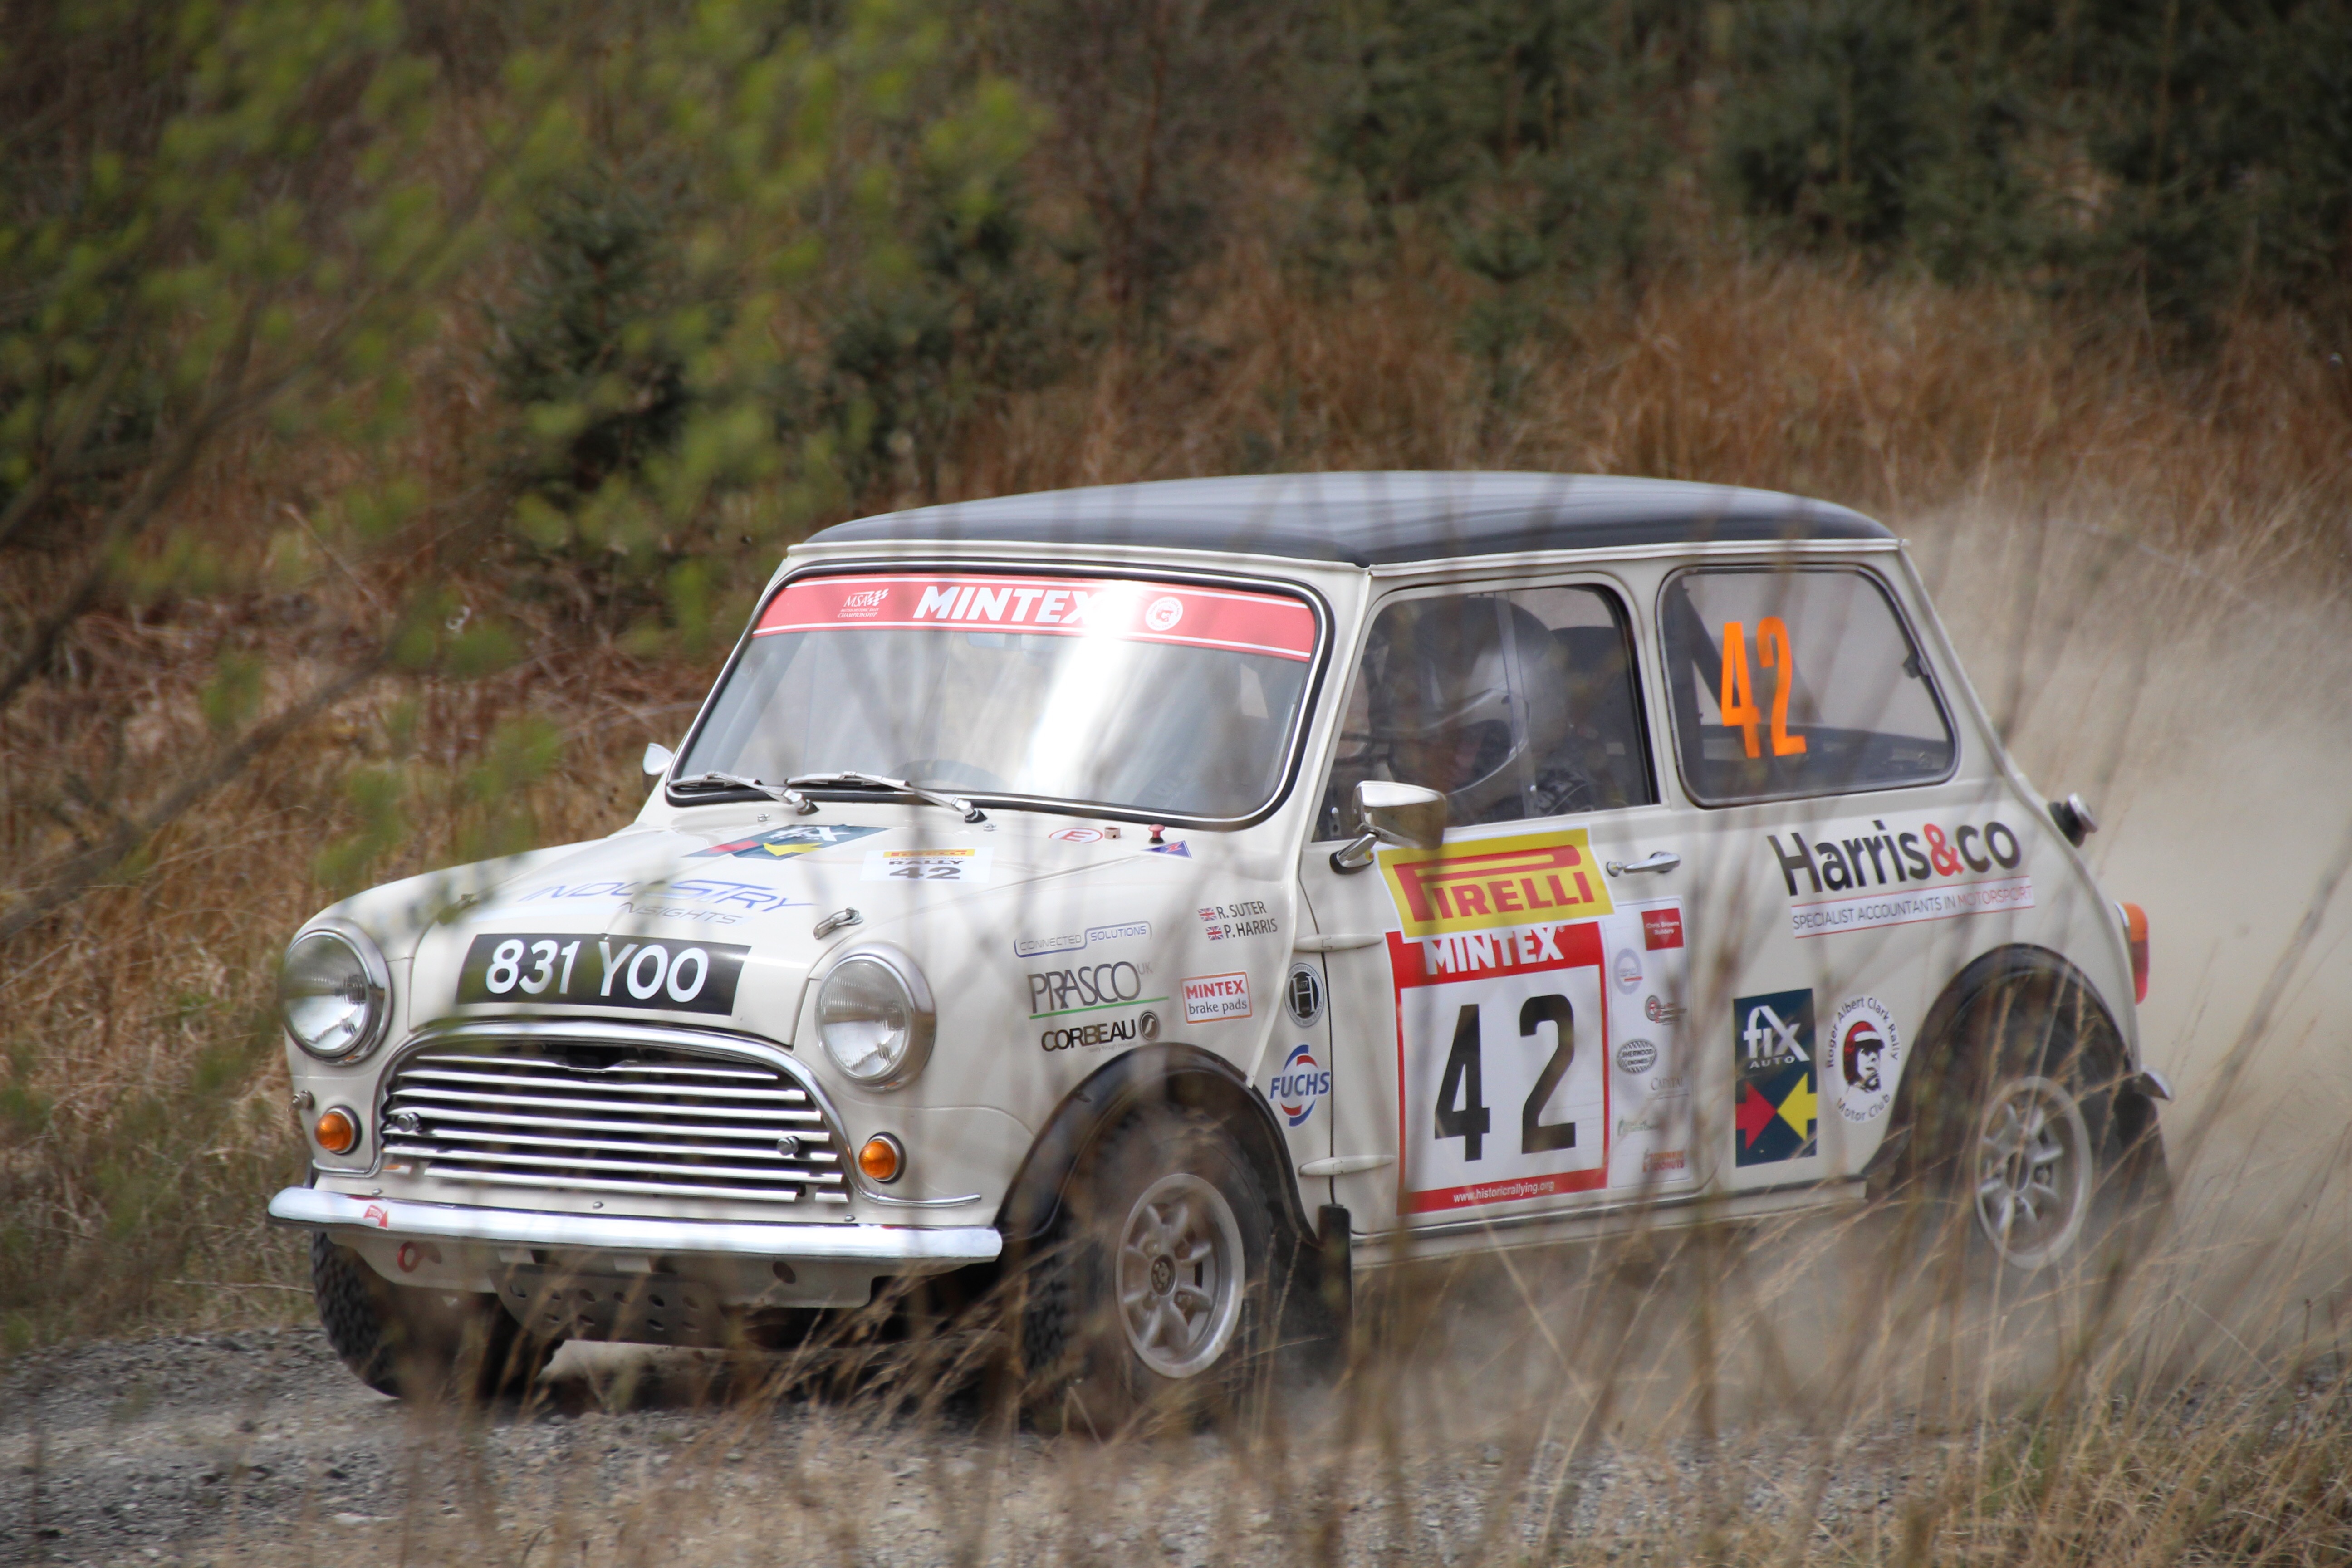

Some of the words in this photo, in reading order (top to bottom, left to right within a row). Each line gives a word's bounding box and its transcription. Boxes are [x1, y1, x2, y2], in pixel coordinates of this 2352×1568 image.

[843, 595, 867, 607] MSA
[912, 586, 1101, 624] MINTEX
[1721, 616, 1807, 759] 42
[889, 867, 961, 880] 42
[1767, 820, 2021, 897] Harris&co
[1393, 844, 1595, 923] PIRELLI
[617, 902, 744, 925] NSIGHTS
[1216, 906, 1229, 920] R.
[1229, 901, 1267, 918] SUTER
[1793, 909, 1854, 930] SPECIALIST
[1857, 897, 1942, 921] ACCOUNTANTS
[1944, 895, 1956, 909] IN
[1958, 886, 2034, 906] MOTORSPORT
[1020, 934, 1082, 951] CONNECTED
[1090, 925, 1147, 941] SOLUTIONS
[1224, 924, 1235, 939] P.
[1236, 918, 1278, 937] HARRIS
[1423, 926, 1564, 975] MINTEX
[485, 939, 581, 995] 831
[598, 941, 709, 1003] YOO
[1028, 961, 1142, 1014] PRASCO
[1136, 962, 1154, 975] UK
[1185, 979, 1245, 999] MINTEX
[1188, 1001, 1220, 1015] brake
[1222, 999, 1248, 1014] pads
[1041, 1019, 1137, 1052] CORBEAU
[1743, 1005, 1811, 1062] fix
[1826, 1023, 1838, 1068] Roger
[1838, 997, 1865, 1022] Albert
[1867, 997, 1890, 1020] Clark
[1889, 1023, 1900, 1060] Rally
[1749, 1055, 1795, 1069] AUTO
[1269, 1072, 1330, 1100] FUCHS
[1435, 994, 1576, 1162] 42
[1838, 1097, 1866, 1121] Motor
[1869, 1093, 1891, 1118] Club
[1453, 1180, 1555, 1203] www.historicrallying.org
